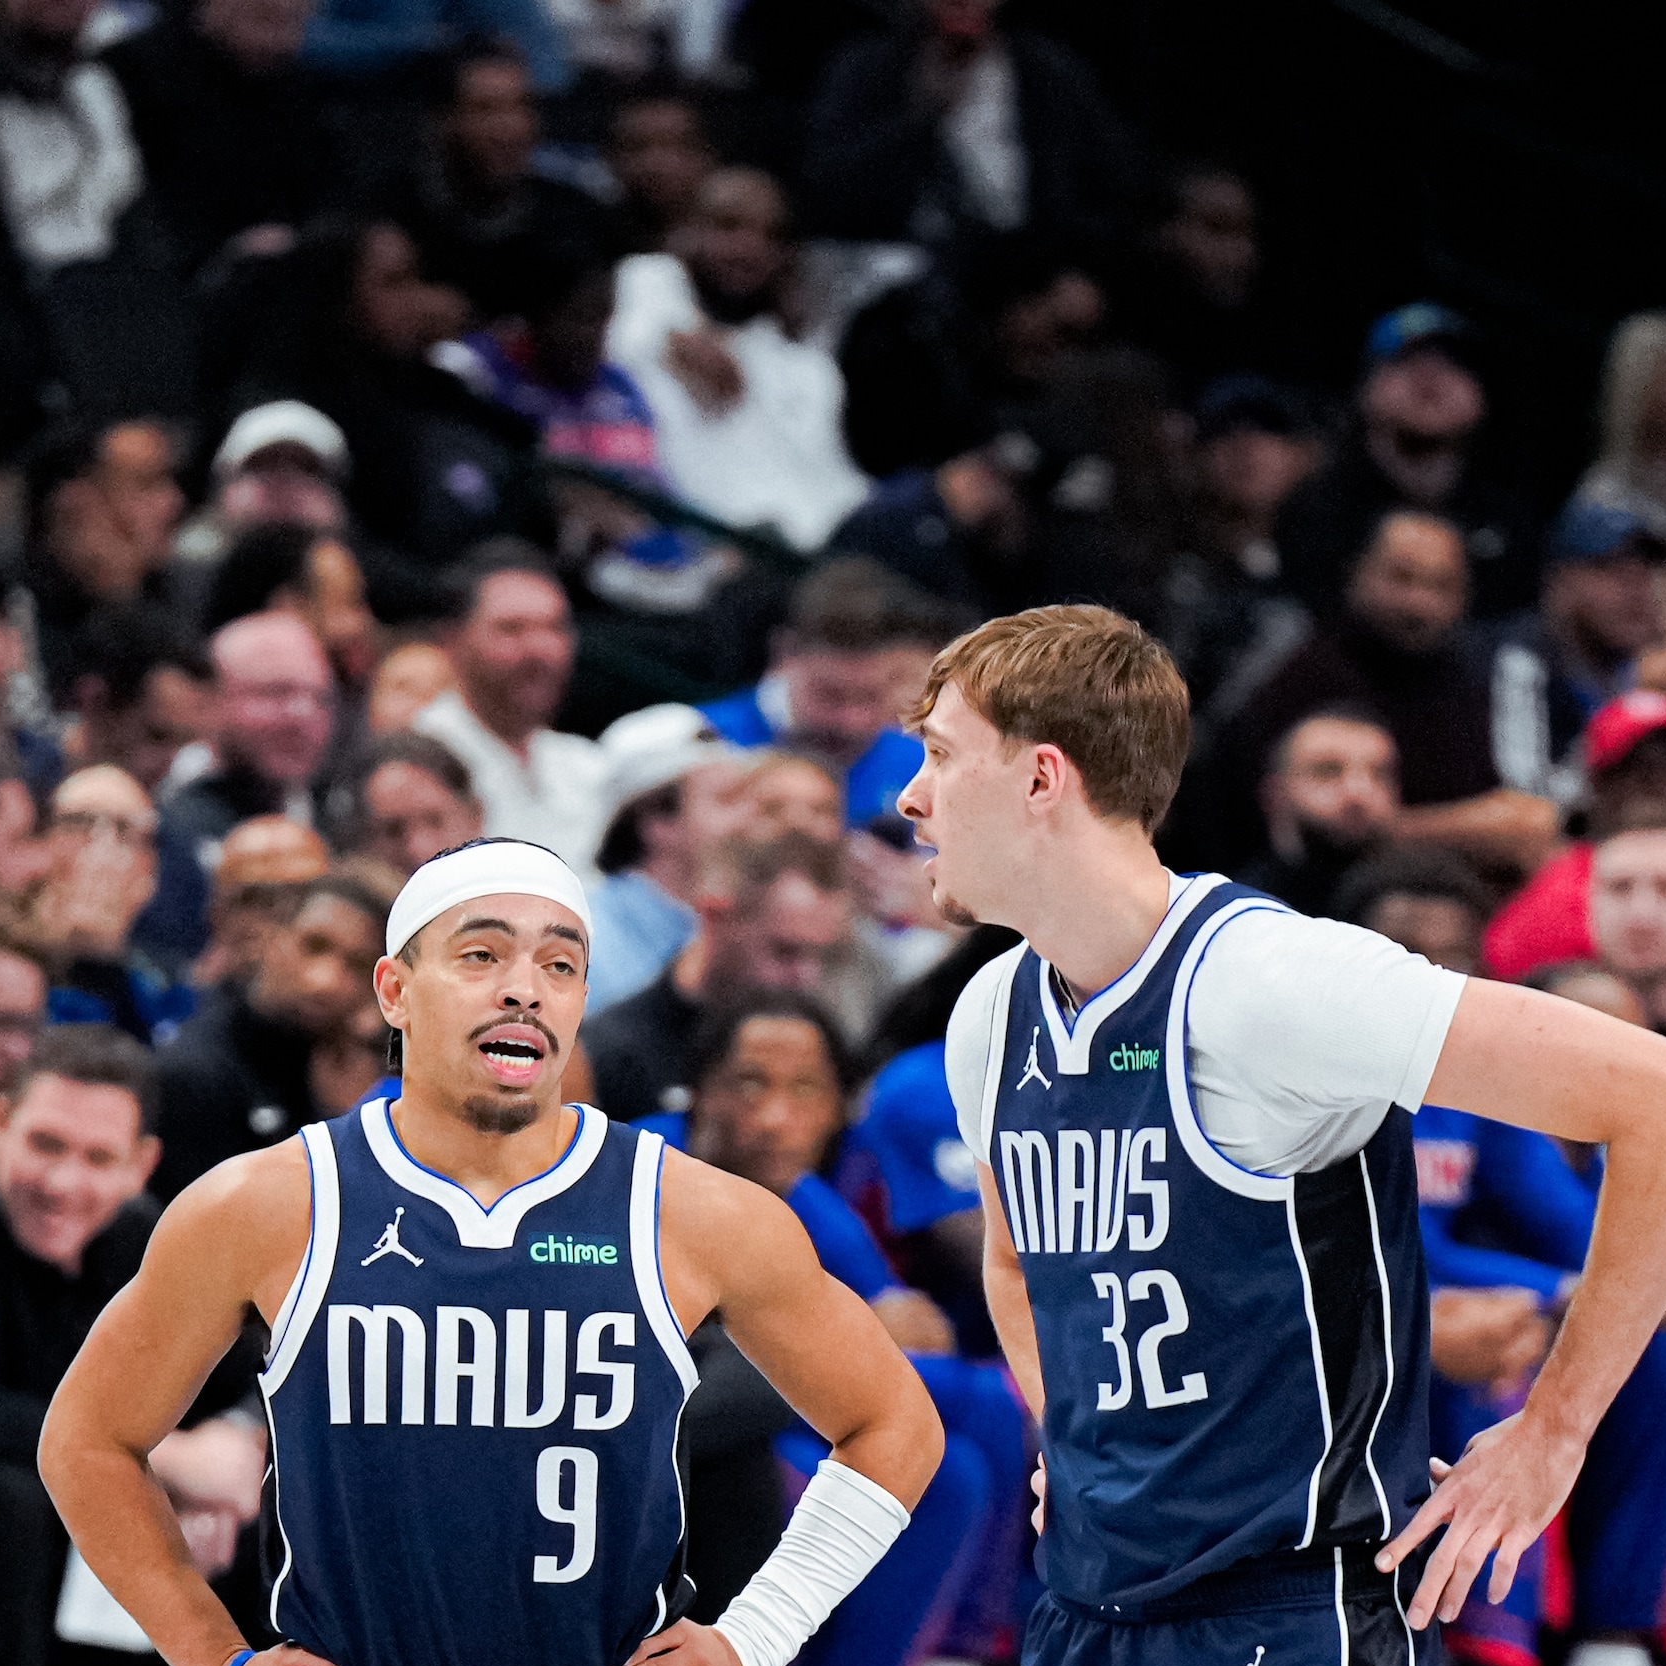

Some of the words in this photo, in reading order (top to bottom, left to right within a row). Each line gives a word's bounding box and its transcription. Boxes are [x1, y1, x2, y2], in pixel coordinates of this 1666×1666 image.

[1110, 1043, 1160, 1071] chime
[530, 1235, 619, 1265] chime
[999, 1127, 1171, 1254] MAVS
[327, 1304, 636, 1430] MAVS
[1090, 1269, 1208, 1412] 32
[533, 1446, 599, 1583] 9
